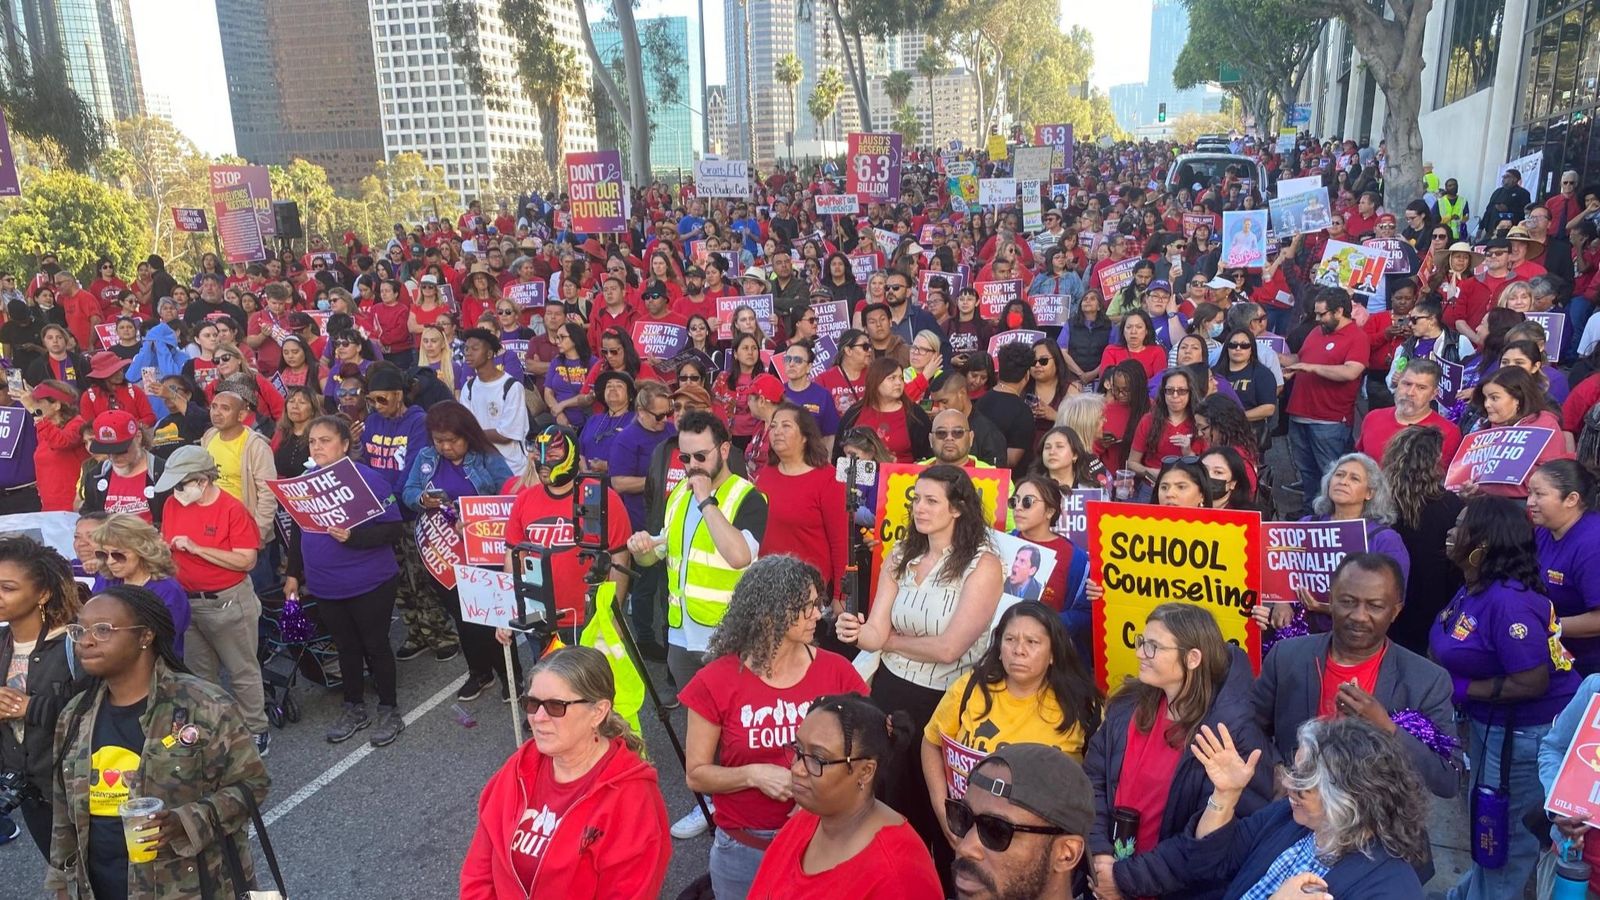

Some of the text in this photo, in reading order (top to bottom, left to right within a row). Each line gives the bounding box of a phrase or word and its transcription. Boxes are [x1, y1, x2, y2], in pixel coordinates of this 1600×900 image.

[859, 136, 890, 145] LAUSD'S
[858, 146, 890, 154] RESERVE
[570, 164, 604, 181] DON'T
[852, 154, 890, 182] $6.3
[213, 171, 241, 185] STOP
[571, 182, 620, 200] CUT OUR
[857, 182, 888, 193] BILLION
[573, 201, 622, 218] FUTURE!
[1369, 240, 1400, 249] STOP THE
[860, 256, 871, 264] THE
[855, 272, 866, 280] UTS!
[984, 282, 1016, 293] STOP THE
[982, 293, 1016, 304] CARVALHO
[1034, 297, 1050, 305] STOP
[824, 304, 836, 313] LOS
[990, 304, 1006, 314] CUT
[1032, 305, 1063, 314] CARVALHO
[1038, 313, 1055, 321] CUTS!
[643, 324, 679, 336] STOP THE
[638, 335, 678, 347] CARVALHO
[997, 333, 1034, 346] STOP THE
[644, 345, 666, 354] CUTS!
[0, 411, 11, 424] HE
[1471, 430, 1532, 449] STOP THE
[277, 470, 341, 498] STOP THE
[288, 486, 354, 513] CARVALHO
[1065, 495, 1084, 511] HE
[466, 503, 500, 516] LAUSD
[310, 507, 350, 527] CUTS!
[475, 522, 505, 536] $6.27
[421, 513, 460, 567] CARVALH
[1269, 528, 1342, 547] STOP THE
[482, 542, 493, 554] IN
[1110, 532, 1227, 571] SCHOOL
[422, 546, 446, 574] STOP
[1268, 551, 1347, 572] CARVALHO
[1289, 572, 1330, 593] CUTS!
[1103, 562, 1257, 617] Counseling
[462, 596, 490, 623] Way
[749, 725, 800, 748] EQUI
[1555, 798, 1572, 811] UTLA
[510, 830, 551, 858] QUI
